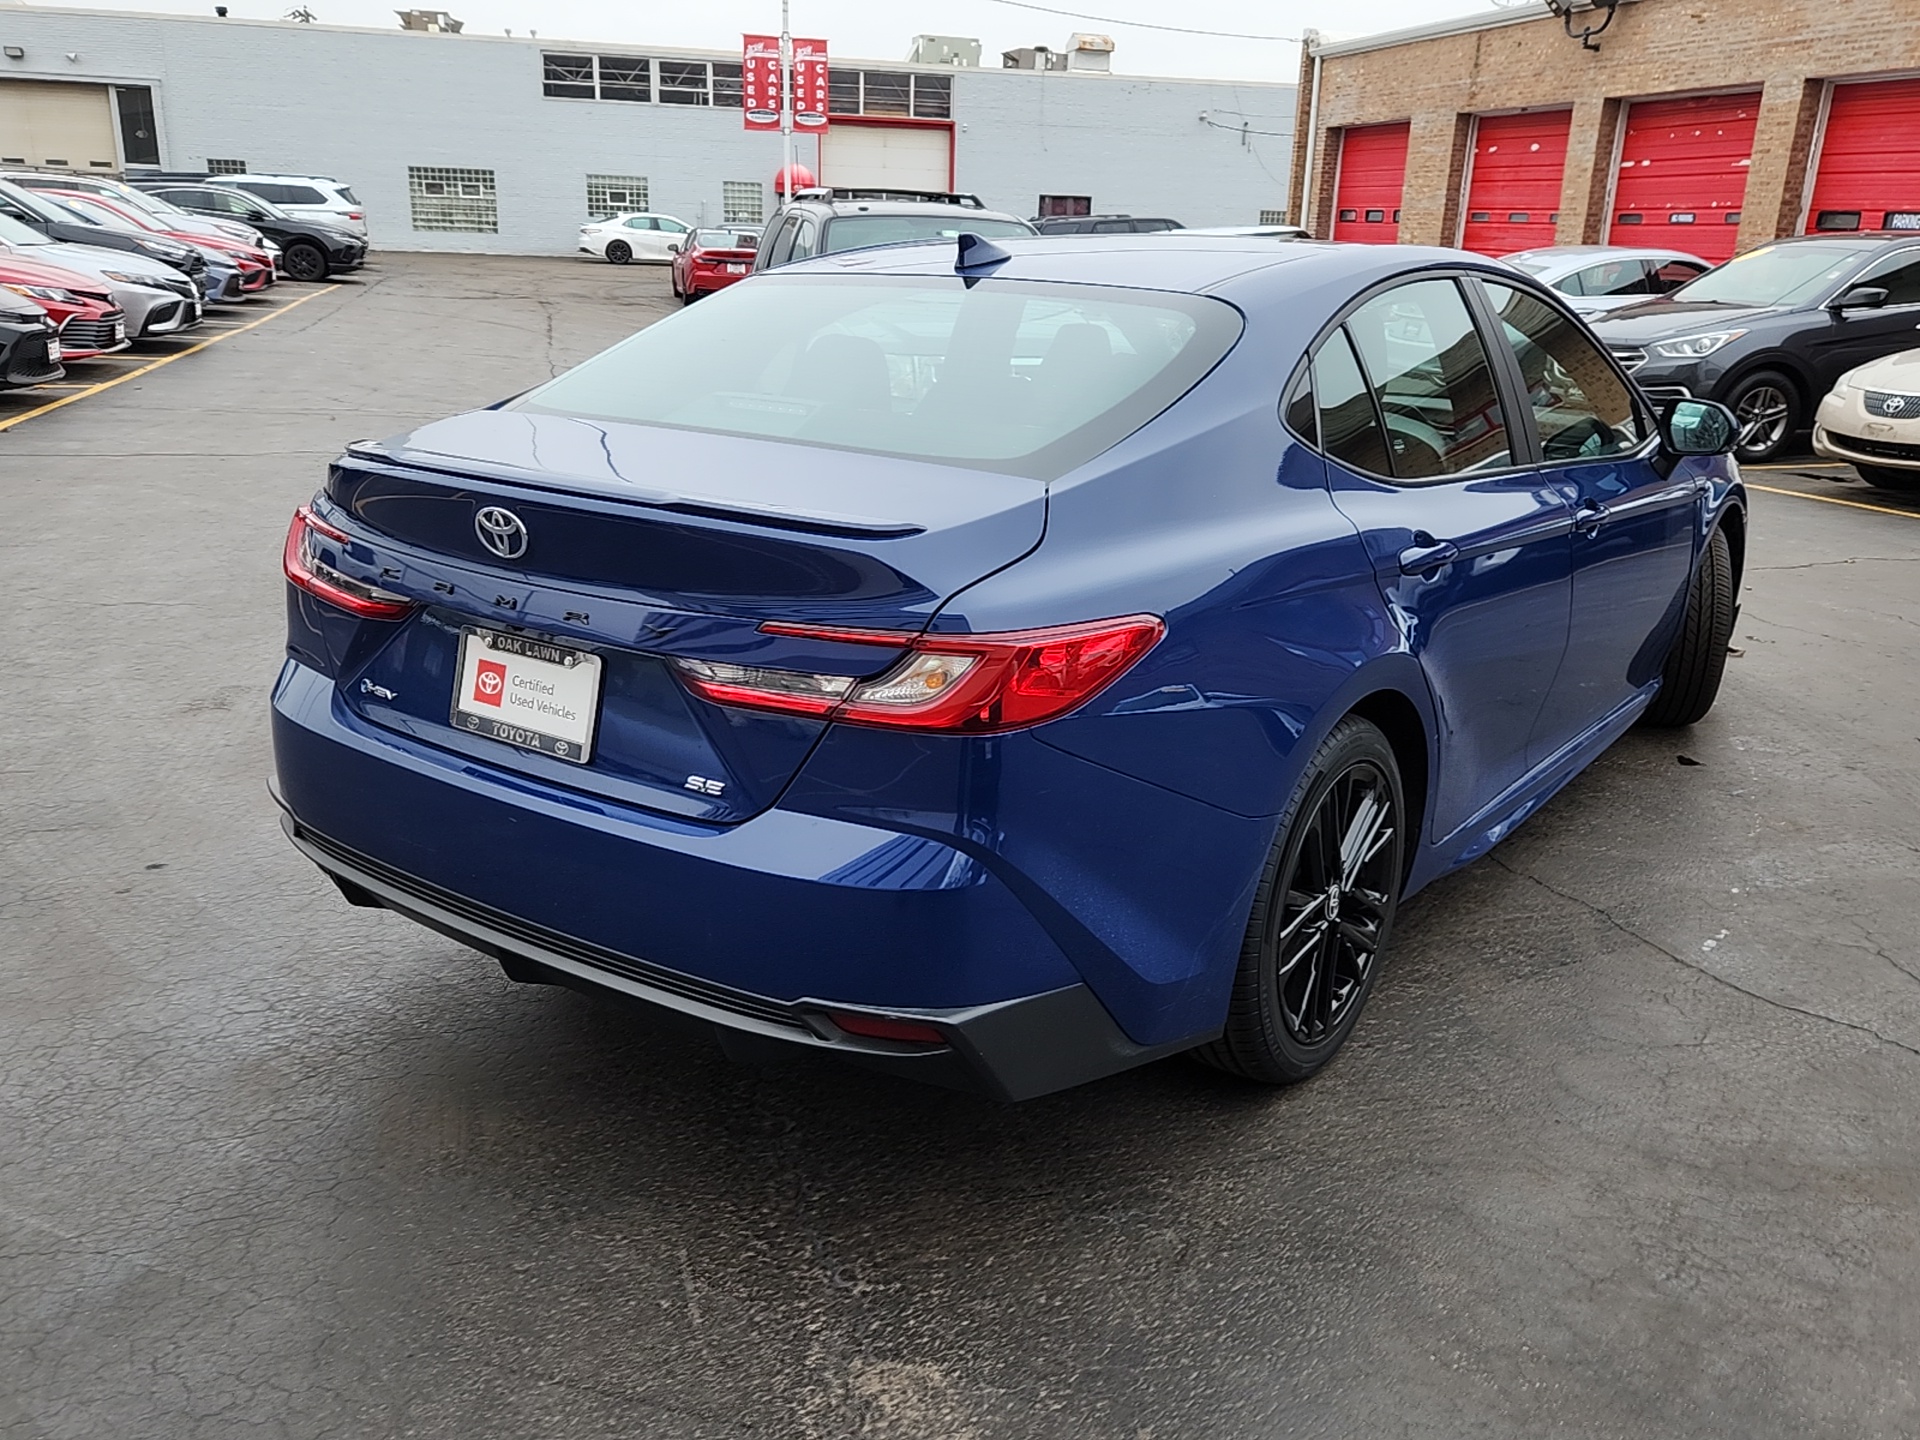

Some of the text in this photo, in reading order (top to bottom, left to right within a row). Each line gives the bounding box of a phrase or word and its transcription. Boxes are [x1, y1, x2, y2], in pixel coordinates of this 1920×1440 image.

[746, 59, 757, 108] USED
[767, 60, 778, 109] CARS
[796, 62, 806, 110] USED
[815, 64, 826, 112] CARS
[497, 637, 561, 662] OAK LAWN
[512, 674, 555, 696] Certified
[509, 692, 577, 721] Used Vehicles
[491, 721, 541, 747] TOYOTA
[683, 775, 726, 796] SE
